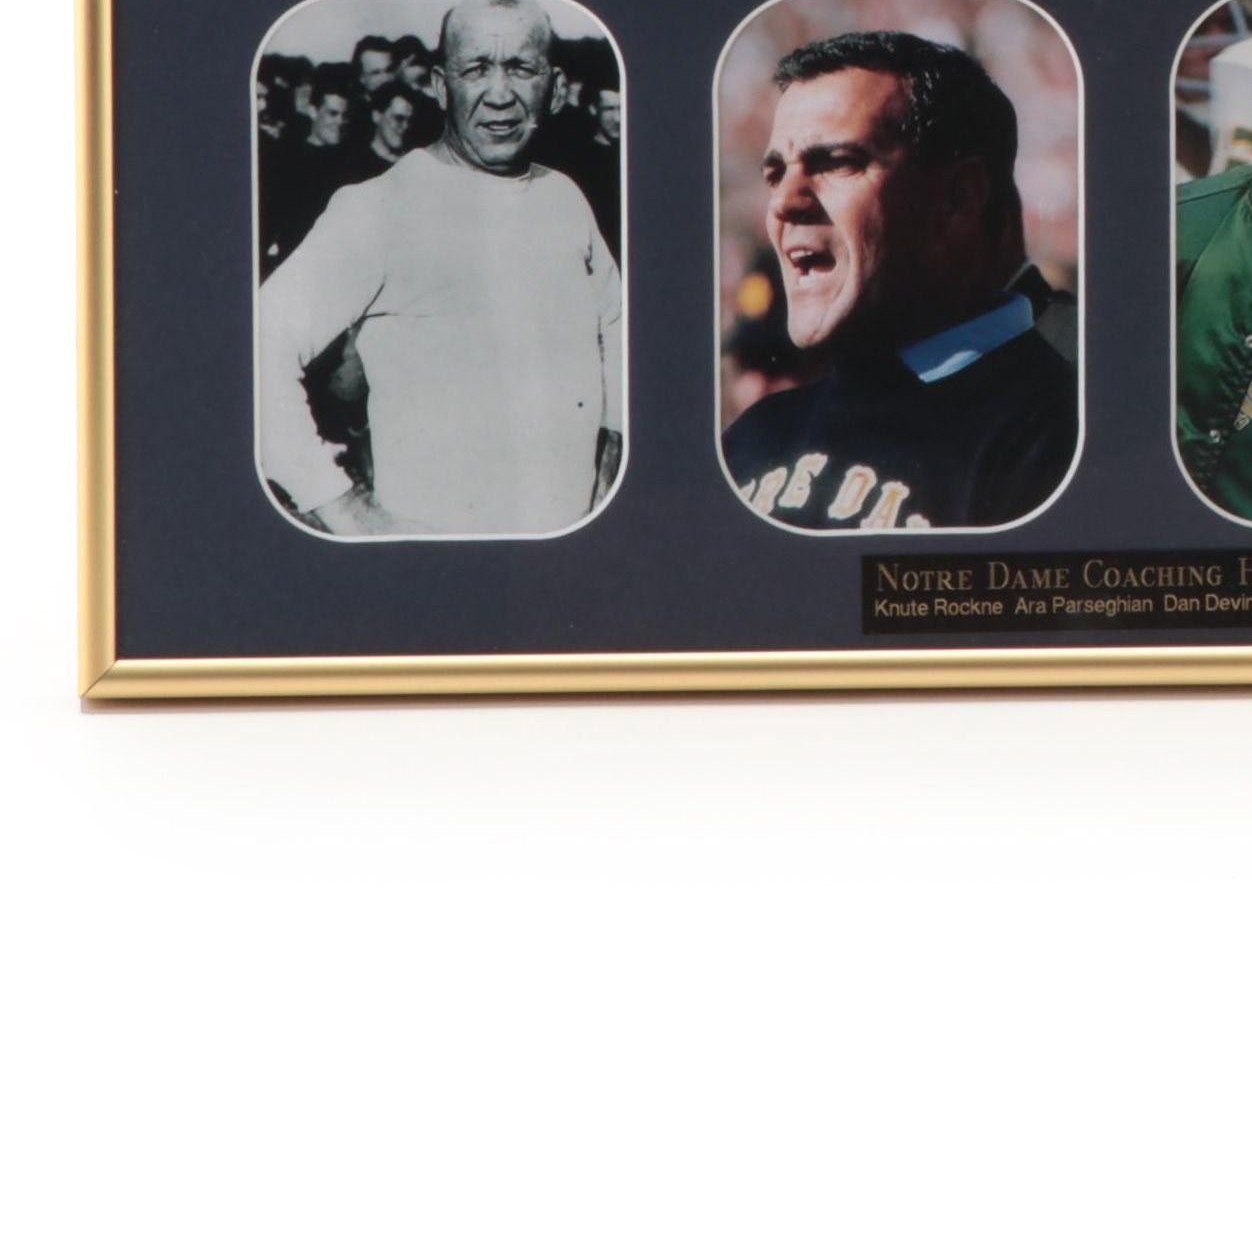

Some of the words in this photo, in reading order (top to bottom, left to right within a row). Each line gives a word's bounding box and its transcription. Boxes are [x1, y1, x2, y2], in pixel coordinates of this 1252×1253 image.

[874, 599, 929, 617] Knute
[934, 598, 1004, 616] Rockne
[1015, 597, 1047, 614] Ara
[1052, 596, 1154, 617] Parseghian
[1164, 594, 1200, 612] Dan
